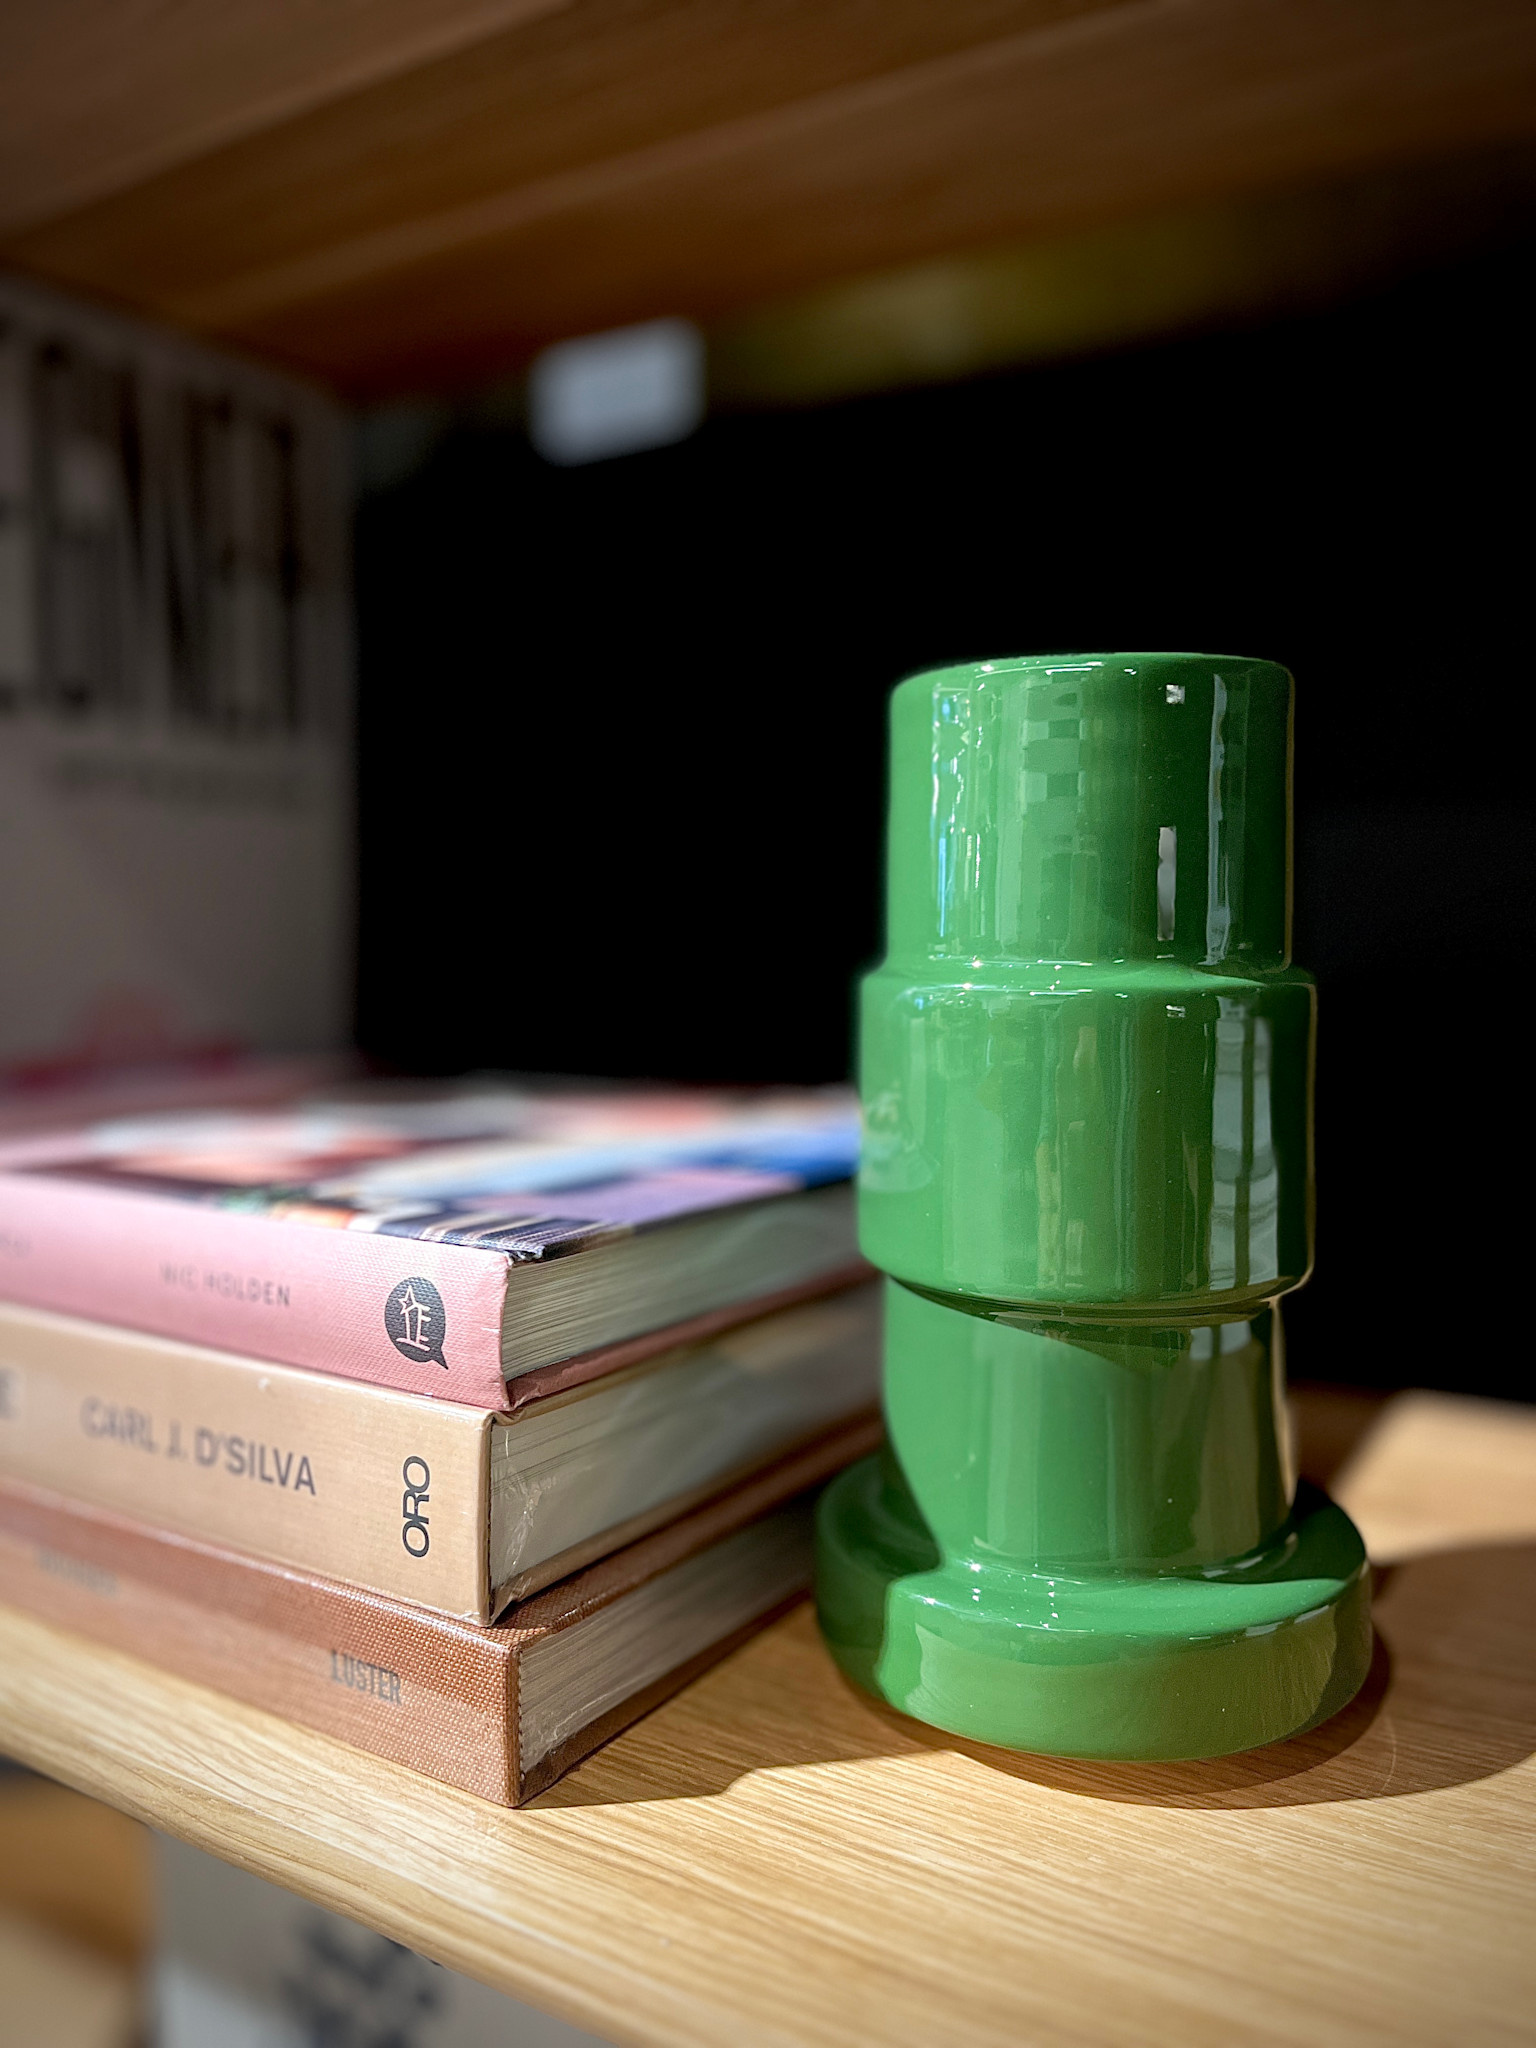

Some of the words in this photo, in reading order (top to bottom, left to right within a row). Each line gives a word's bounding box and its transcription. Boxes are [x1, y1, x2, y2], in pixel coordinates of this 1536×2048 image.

[203, 1269, 290, 1306] HOLDEN
[80, 1397, 158, 1453] CARL
[195, 1425, 317, 1497] D'SILVA
[402, 1455, 430, 1558] ORO
[331, 1649, 402, 1706] LUSTER
